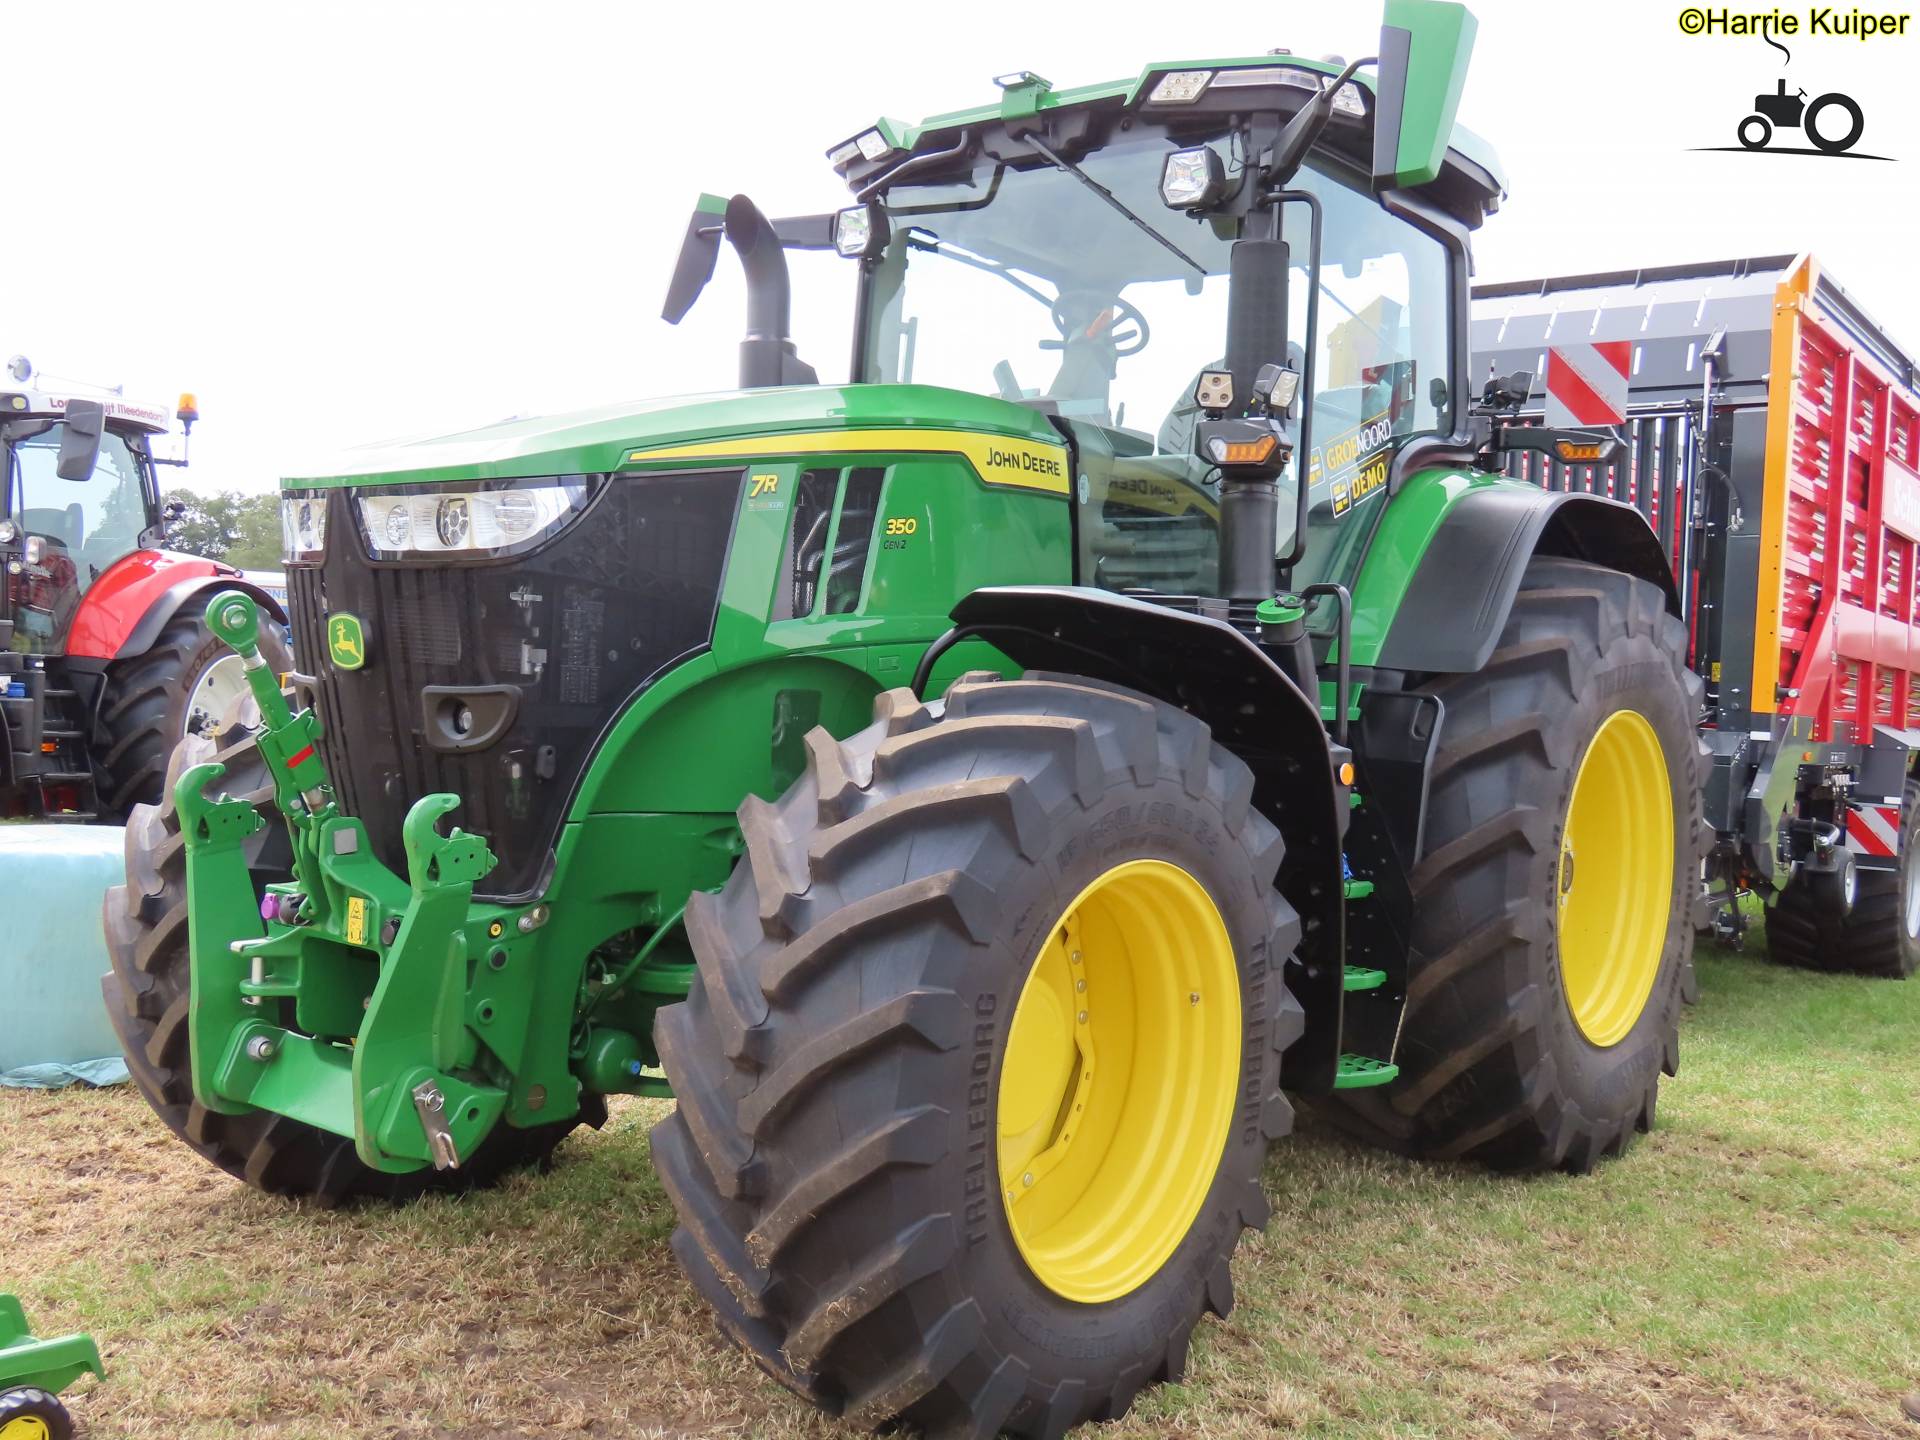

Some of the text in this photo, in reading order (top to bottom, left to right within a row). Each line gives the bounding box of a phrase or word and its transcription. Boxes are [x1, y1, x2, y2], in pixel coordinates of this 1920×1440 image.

[986, 447, 1062, 477] JOHN DEERE
[1326, 418, 1392, 470] GROENOORD
[749, 473, 779, 499] 7R
[1351, 462, 1386, 500] DEMO
[886, 517, 917, 536] 350
[1244, 936, 1267, 1146] TRELLEBORG
[965, 992, 998, 1247] TRELLEBORG
